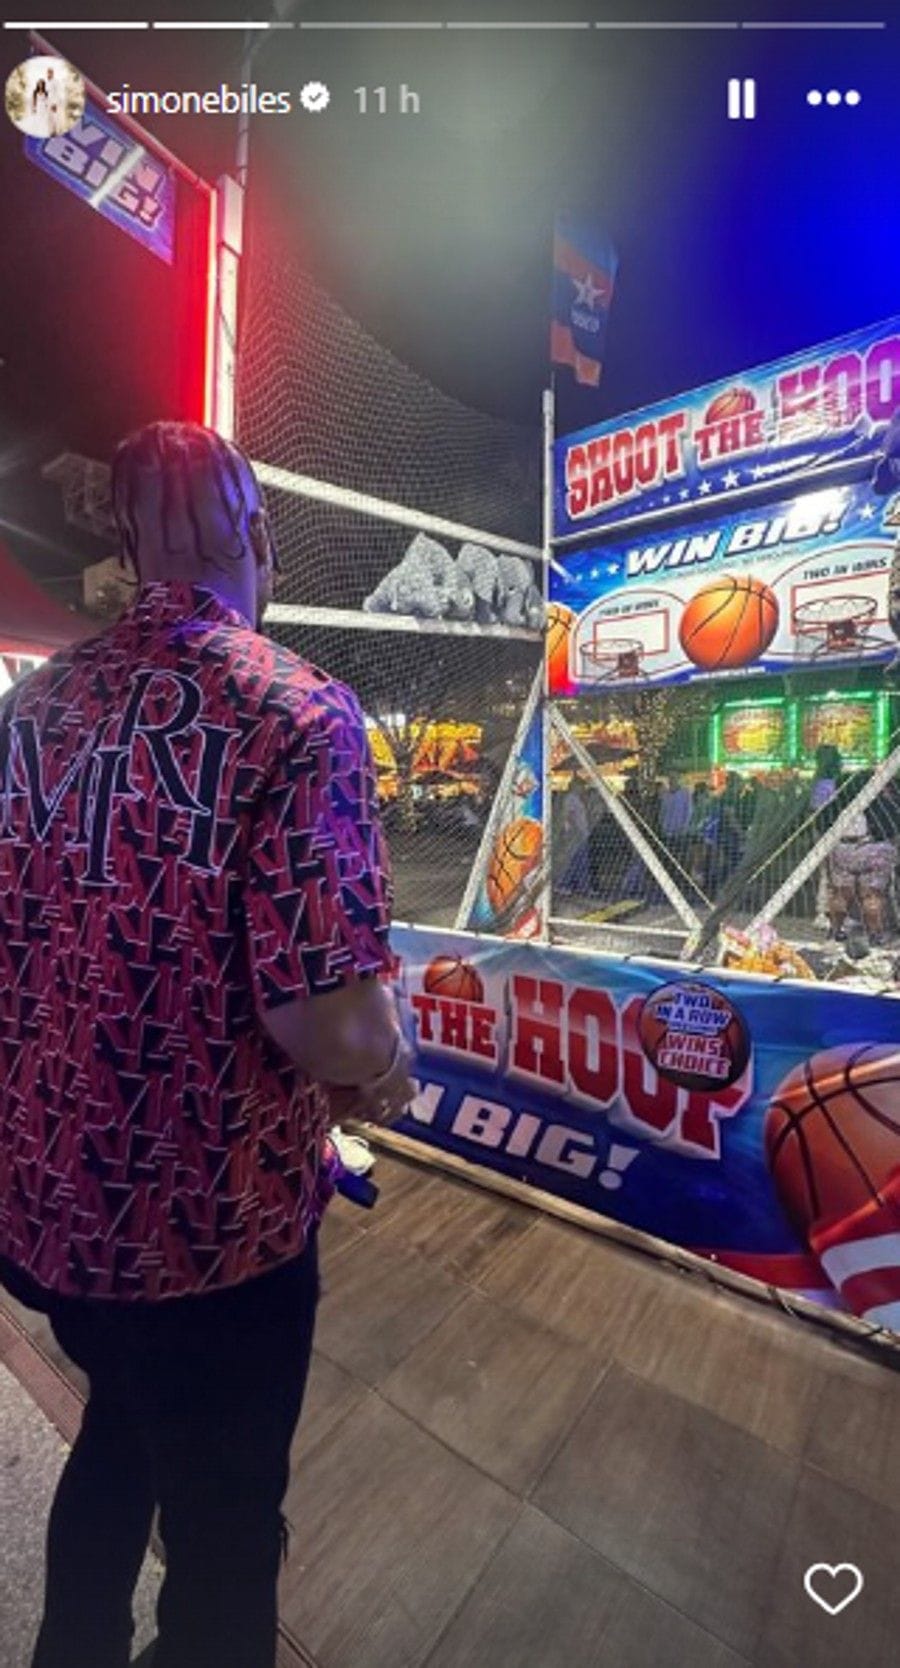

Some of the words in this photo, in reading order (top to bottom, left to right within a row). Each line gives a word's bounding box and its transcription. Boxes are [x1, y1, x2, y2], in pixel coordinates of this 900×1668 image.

[567, 412, 686, 516] SHOOT
[695, 409, 765, 462] THE
[627, 530, 721, 578] WIN
[727, 487, 852, 556] BIG!
[674, 1006, 685, 1019] A
[688, 1009, 728, 1025] ROW
[675, 992, 710, 1008] TWO
[411, 995, 497, 1060] THE
[669, 1034, 719, 1056] WINS
[660, 1051, 728, 1076] CHOICE
[452, 1094, 640, 1190] BIG!
